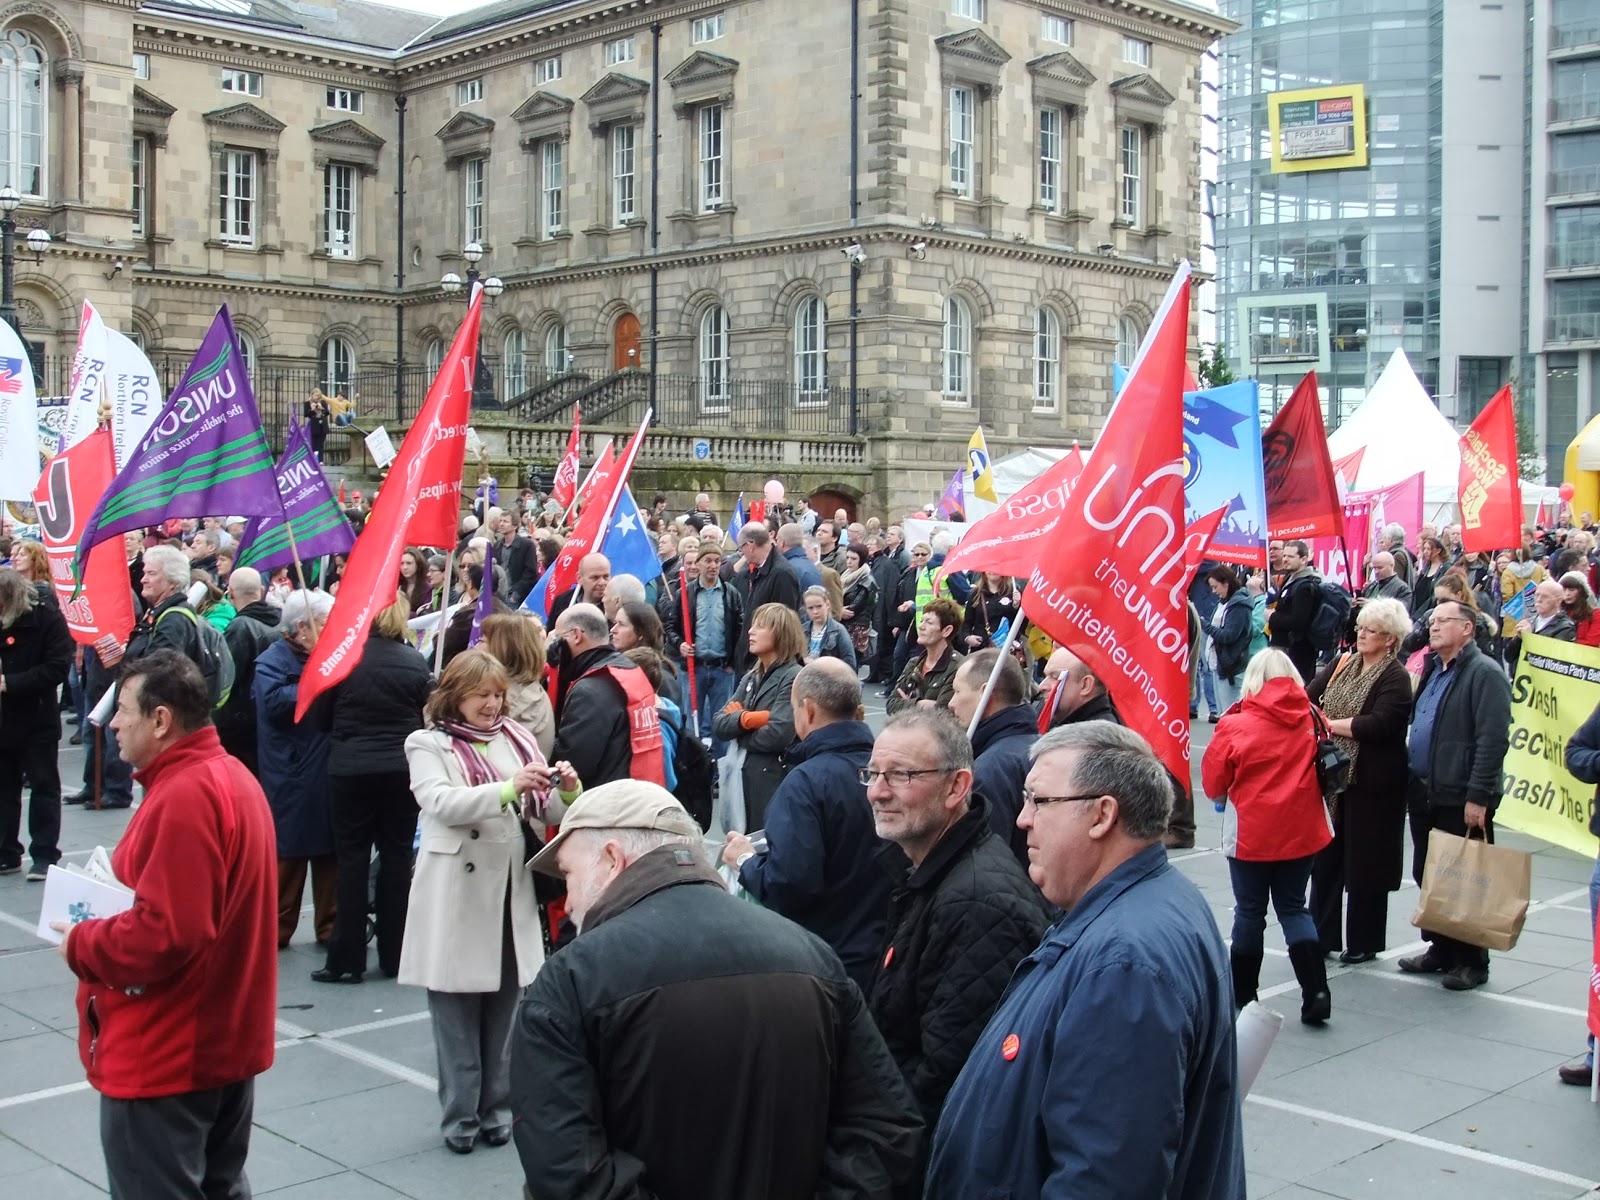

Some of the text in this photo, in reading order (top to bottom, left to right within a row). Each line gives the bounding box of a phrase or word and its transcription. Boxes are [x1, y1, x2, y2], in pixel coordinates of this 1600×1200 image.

[1294, 128, 1337, 139] FOR SALE
[80, 358, 105, 402] RCN
[116, 373, 128, 425] Northern
[130, 374, 150, 417] RCN
[1277, 522, 1316, 537] pcs.org.uk
[1319, 549, 1359, 586] UCU
[1545, 658, 1569, 675] Workers
[1568, 664, 1587, 681] Party
[1558, 785, 1584, 824] The
